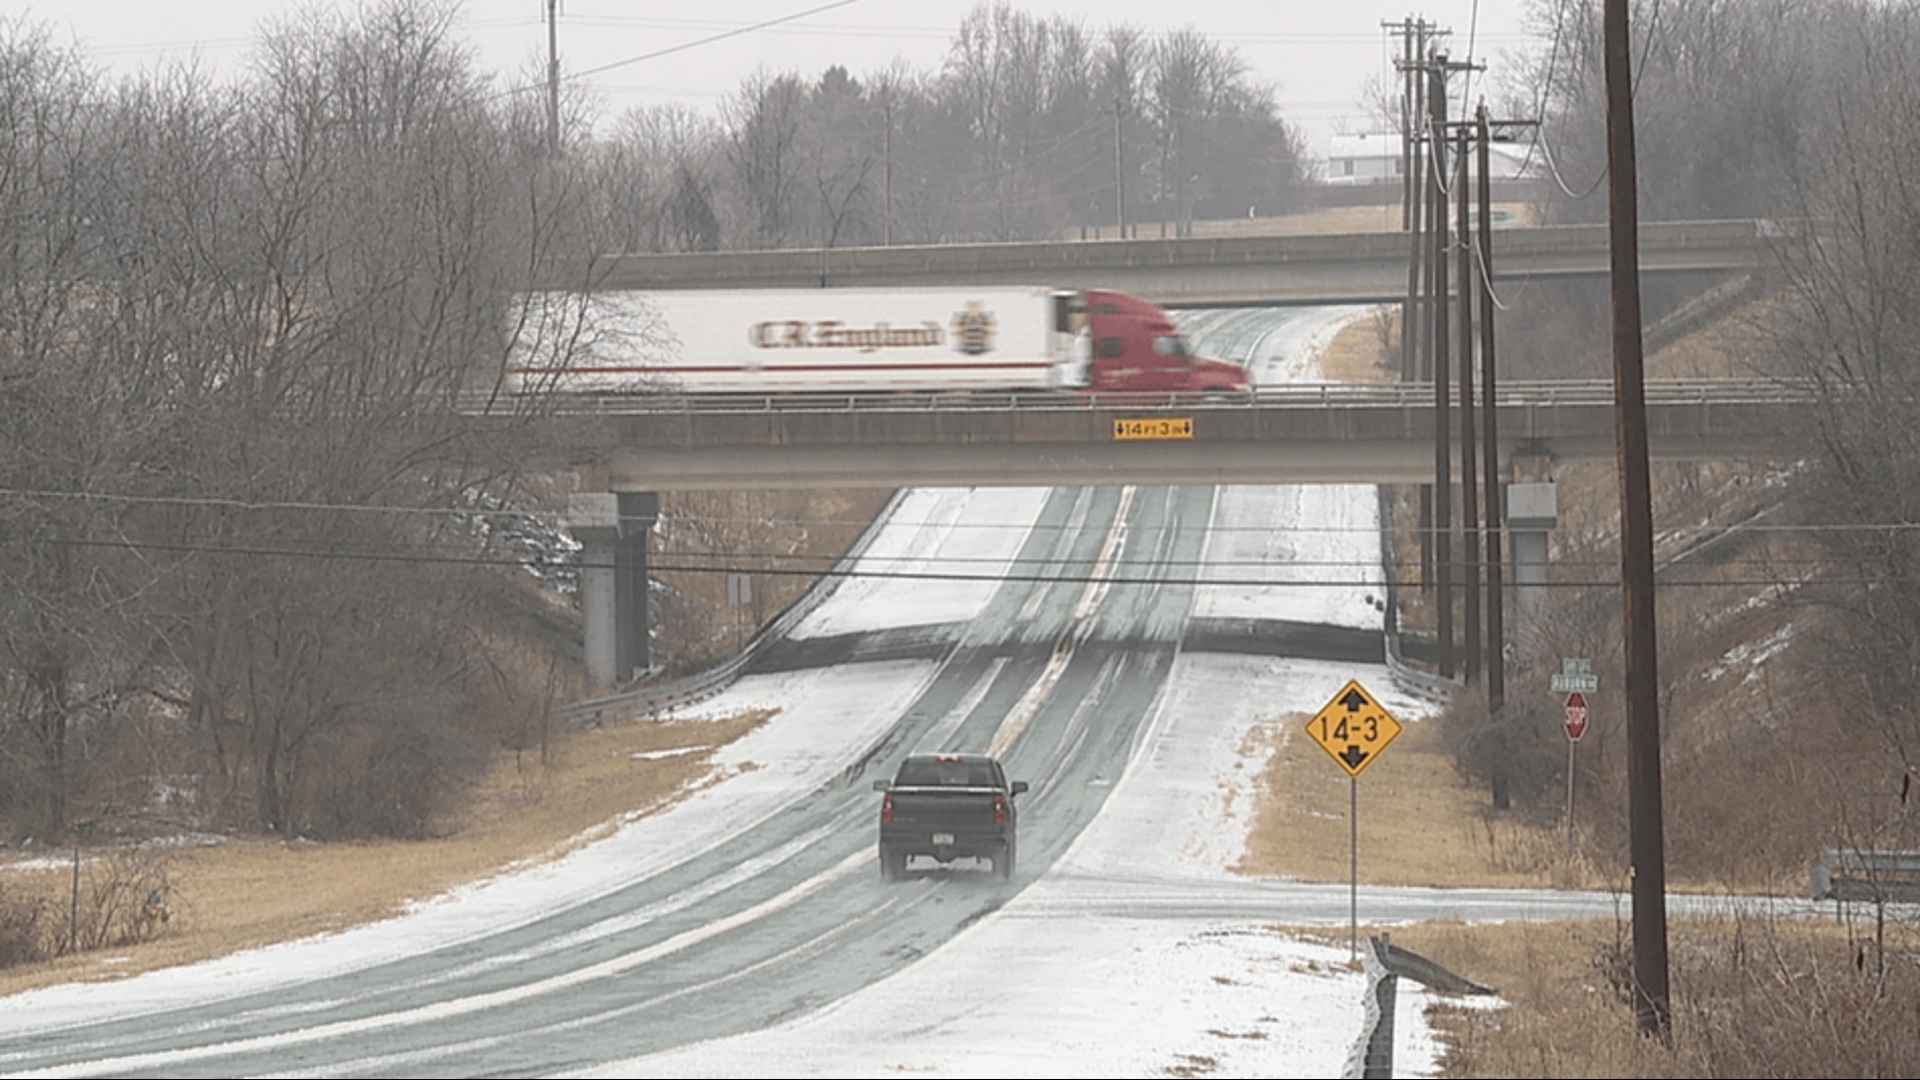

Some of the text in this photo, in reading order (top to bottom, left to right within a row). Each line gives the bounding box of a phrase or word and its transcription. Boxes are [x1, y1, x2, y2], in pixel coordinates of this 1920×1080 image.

[1125, 422, 1142, 436] 14
[1160, 421, 1169, 436] 3
[1565, 706, 1586, 725] STOP
